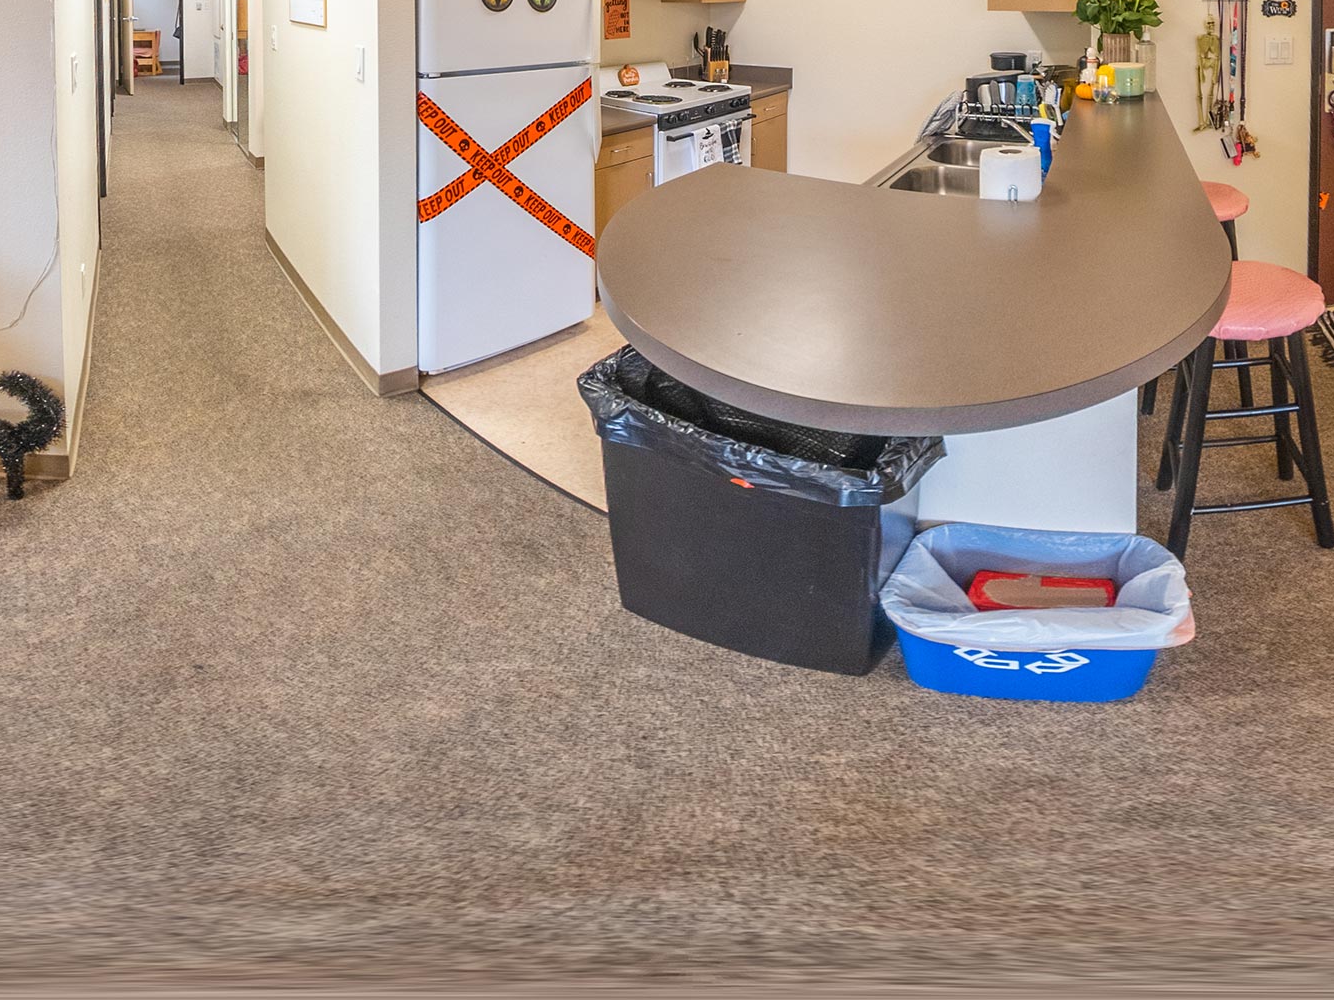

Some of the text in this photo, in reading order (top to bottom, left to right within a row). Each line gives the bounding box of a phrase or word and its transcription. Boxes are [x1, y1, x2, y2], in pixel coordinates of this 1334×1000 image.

[418, 96, 592, 248] EEP OUT KEEP OUT KEEP OUT KEEP
[445, 179, 465, 202] OUT
[494, 146, 511, 163] EEP
[512, 130, 530, 152] OUT
[549, 99, 571, 124] KEEP
[570, 87, 586, 107] OUT
